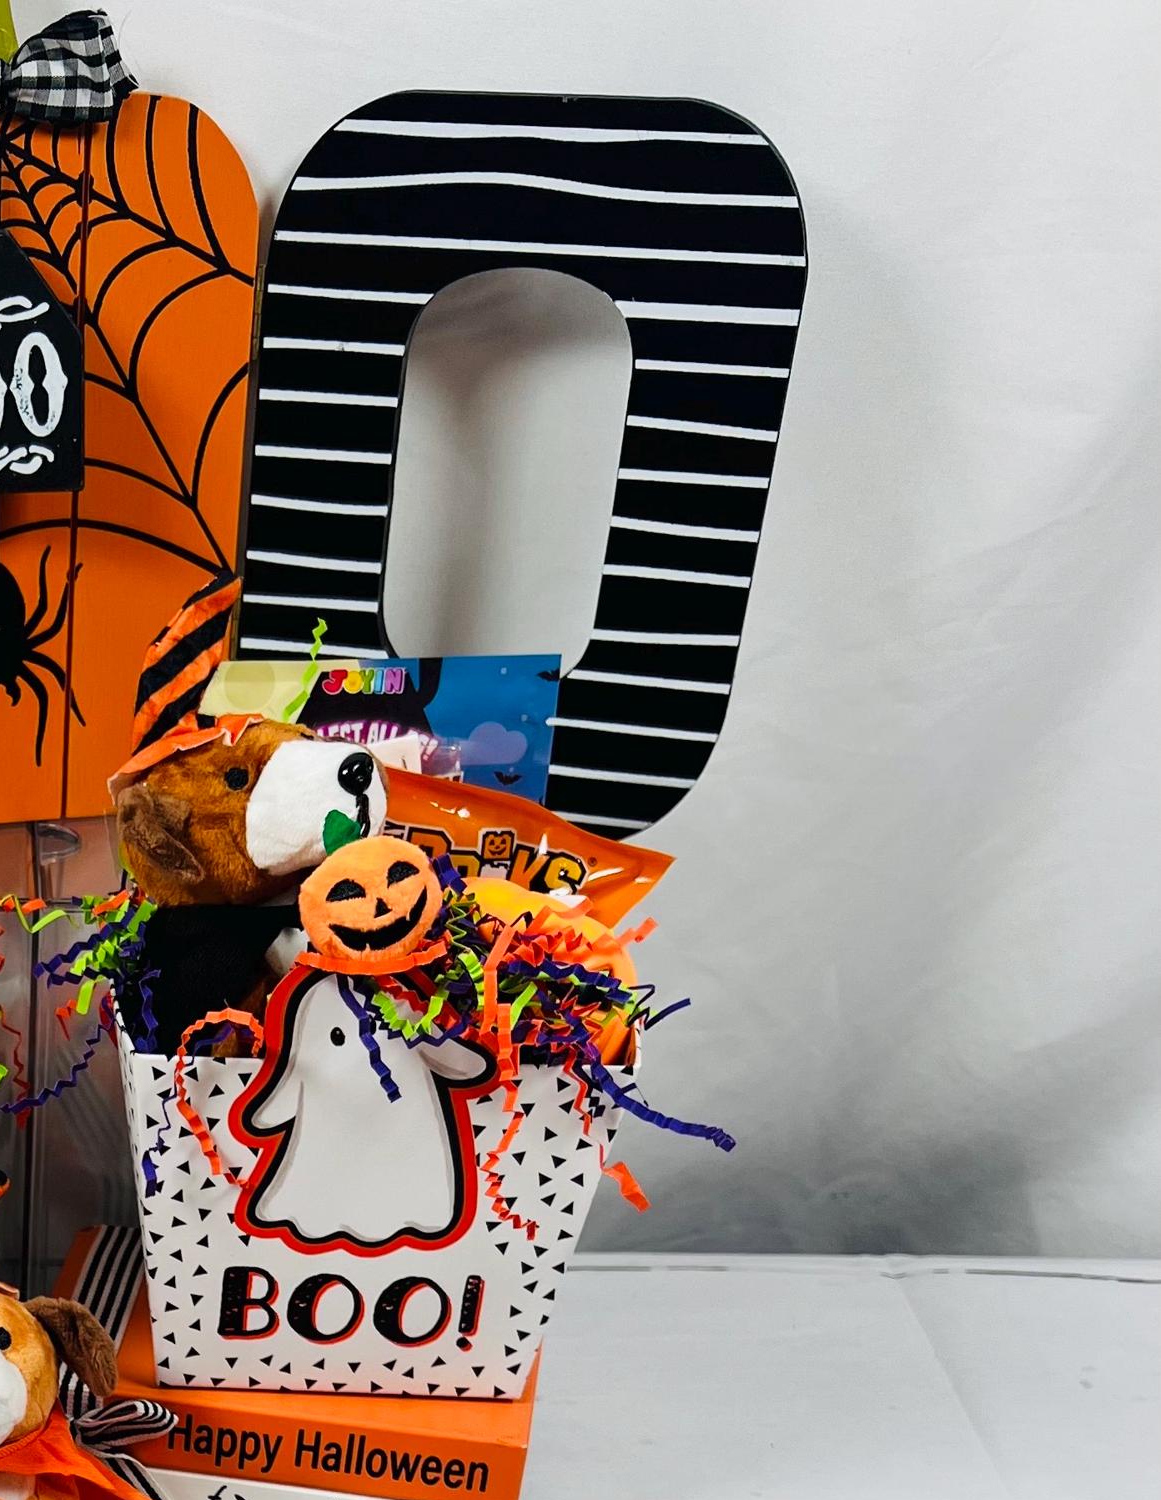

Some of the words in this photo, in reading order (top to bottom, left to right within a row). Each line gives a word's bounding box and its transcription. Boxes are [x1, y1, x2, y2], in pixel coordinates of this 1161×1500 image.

[322, 667, 406, 695] JOYIN
[216, 1266, 485, 1352] BOO!
[166, 1414, 283, 1467] Happy
[294, 1428, 490, 1493] Halloween
